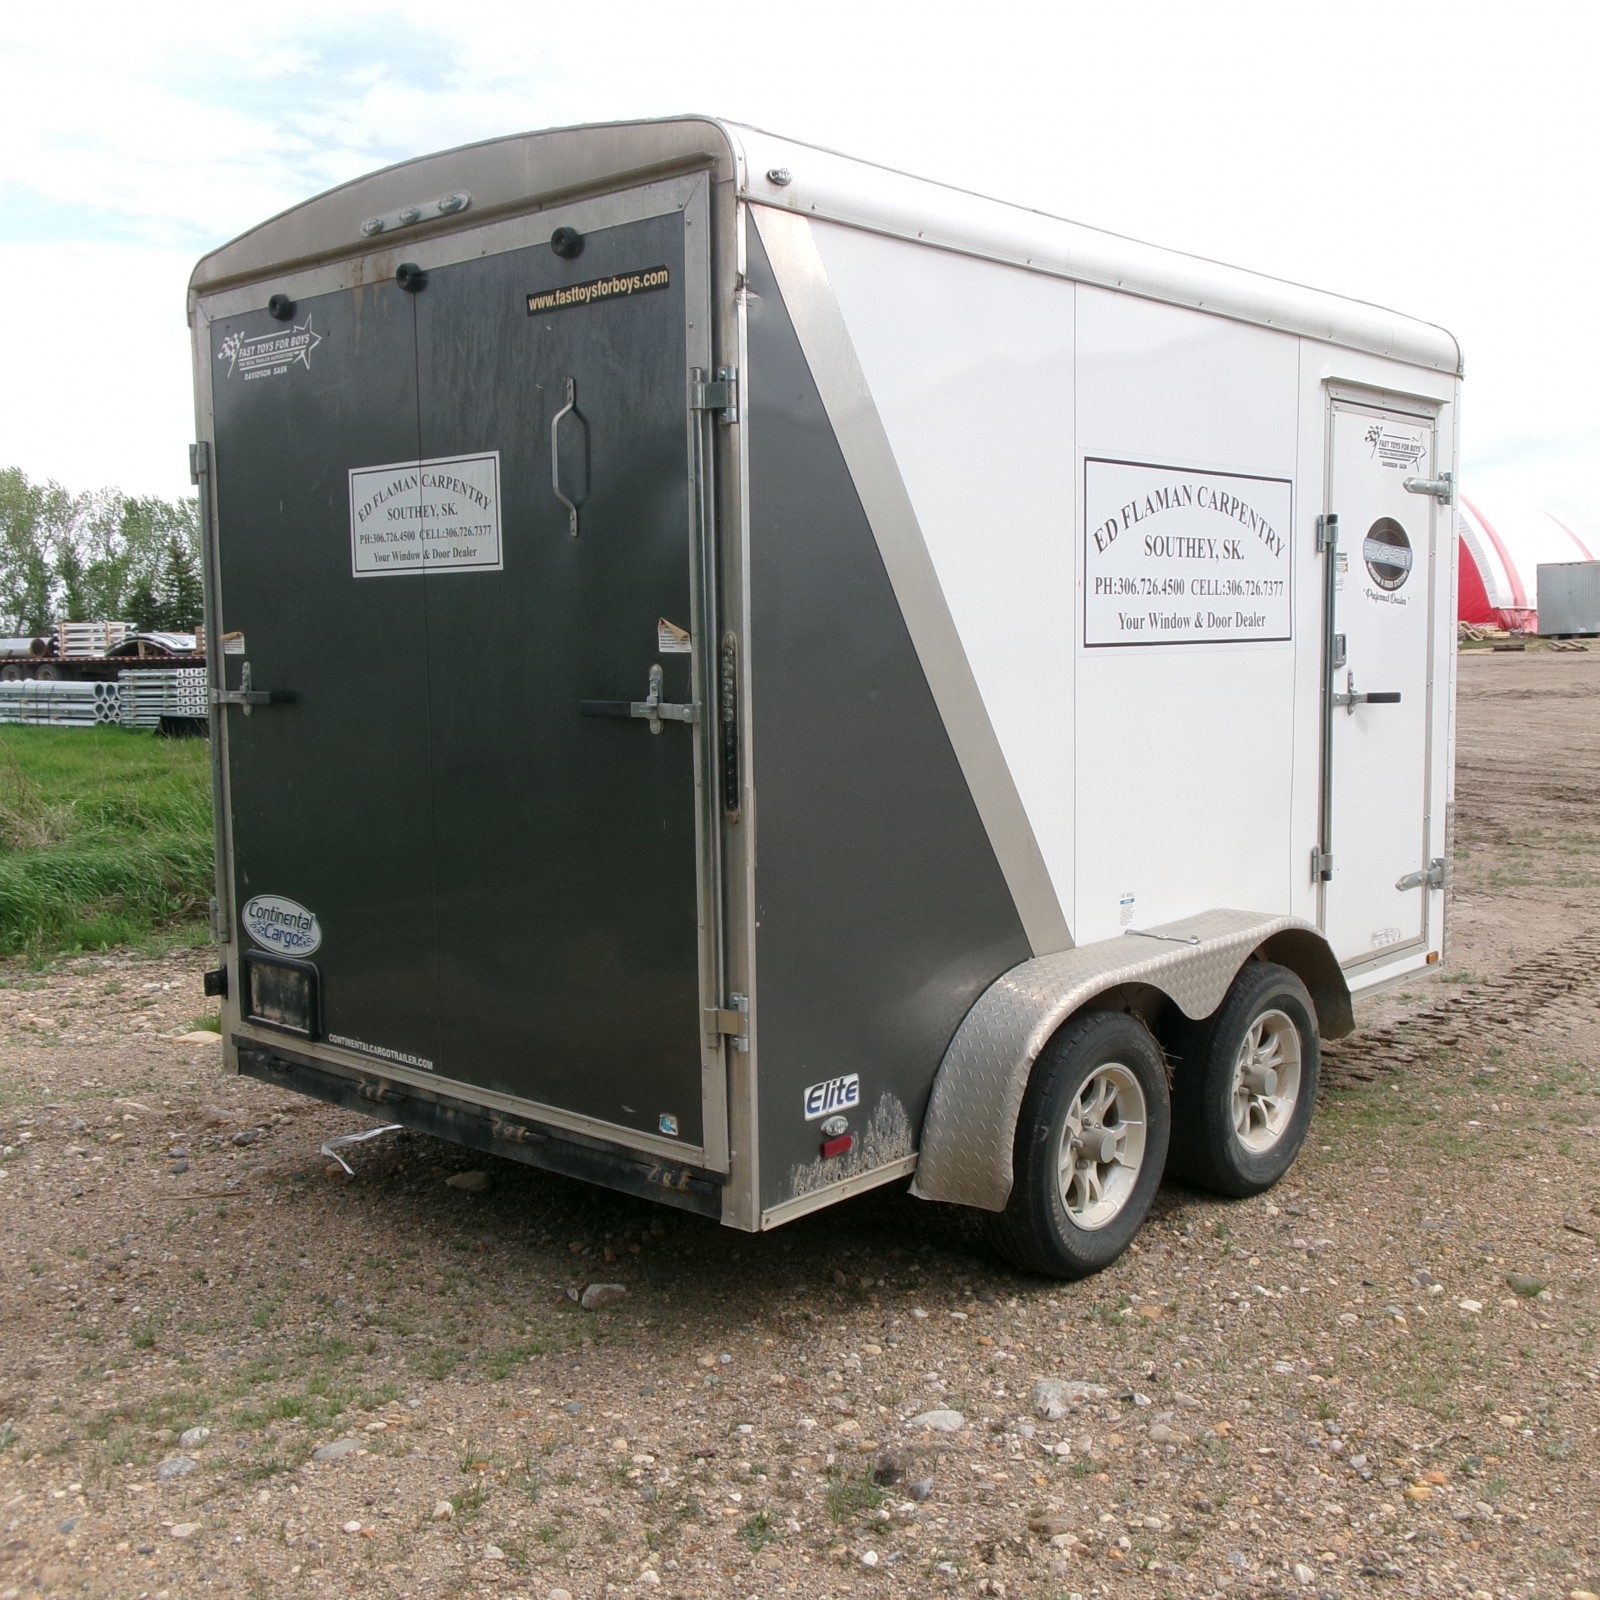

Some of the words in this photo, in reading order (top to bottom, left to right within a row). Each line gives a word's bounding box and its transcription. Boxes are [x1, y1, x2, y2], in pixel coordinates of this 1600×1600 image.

[528, 269, 668, 311] www.fasttoysforboys.com
[239, 345, 255, 358] FAST
[257, 341, 274, 353] TOYS
[275, 338, 290, 350] FOR
[290, 333, 310, 346] BOYS
[244, 368, 271, 380] DAVIDSON
[273, 365, 288, 375] SASK
[357, 502, 372, 523] ED
[372, 474, 418, 508] FLAMAN
[421, 473, 492, 511] CARPENTRY
[441, 502, 458, 517] SK.
[359, 530, 416, 545] PH:306.726.4500
[419, 524, 492, 541] CELL:306.726.7377
[1093, 517, 1119, 555] ED
[1120, 484, 1193, 531] FLAMAN
[1197, 485, 1286, 560] CARPENTRY
[373, 552, 390, 563] Your
[392, 550, 421, 562] Window
[423, 549, 430, 560] &
[432, 548, 450, 559] Door
[452, 546, 477, 558] Dealer
[1222, 538, 1245, 560] SK.
[1094, 576, 1185, 596] PH:306.726.4500
[1190, 578, 1284, 596] CELL:306.726.7377
[1118, 612, 1145, 630] Your
[1148, 611, 1192, 630] Window
[1194, 612, 1204, 629] &
[1207, 611, 1233, 628] Door
[1235, 610, 1266, 628] Dealer
[248, 902, 314, 931] Continental
[264, 923, 302, 948] Cargo
[328, 1033, 434, 1070] CONTINENTALCARGOTRAILER.COM
[806, 1078, 858, 1114] Elite
